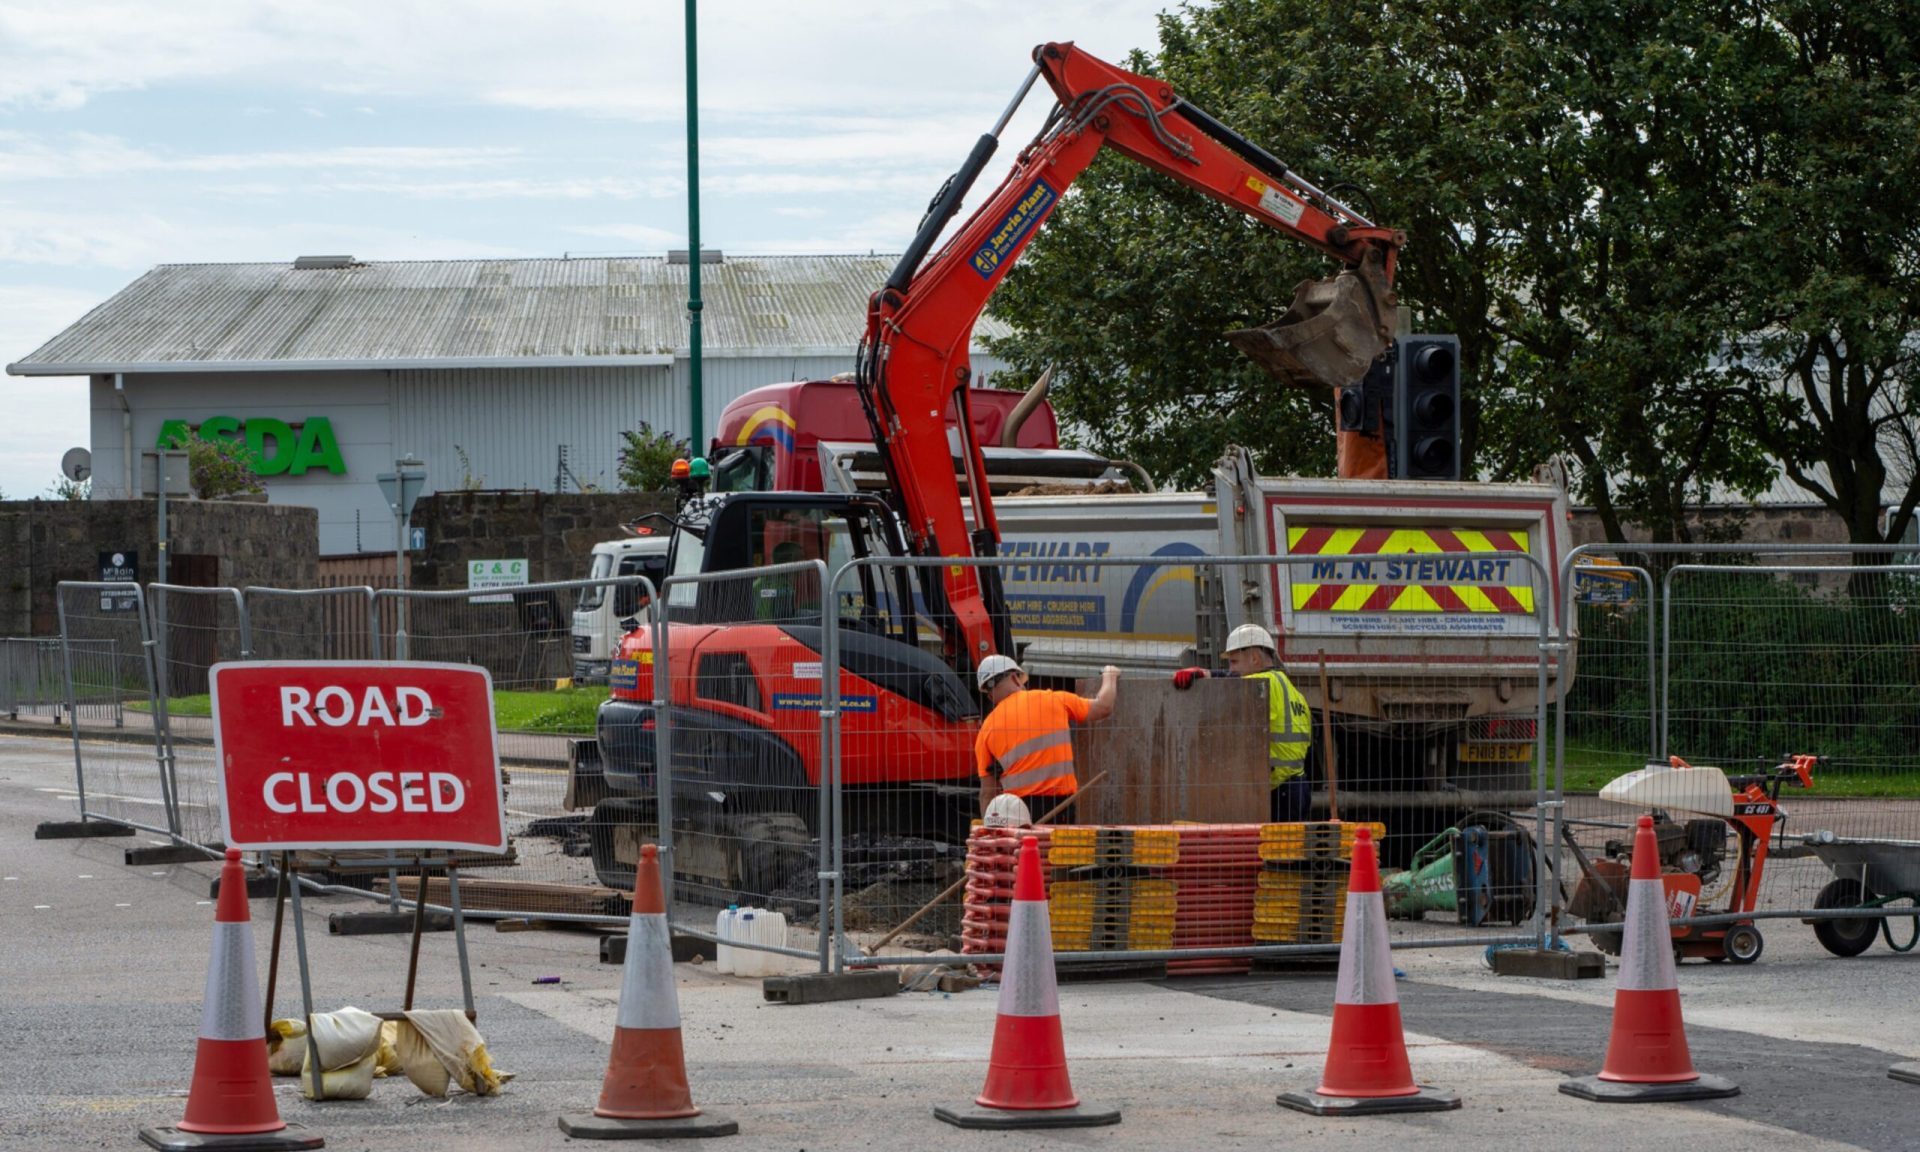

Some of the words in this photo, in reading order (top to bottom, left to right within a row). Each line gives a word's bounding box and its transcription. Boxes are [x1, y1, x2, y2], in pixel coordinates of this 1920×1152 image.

[990, 213, 1023, 249] Jarvie
[1017, 184, 1046, 216] Plant
[473, 562, 484, 575] C
[491, 562, 502, 574] &
[510, 561, 522, 574] C
[996, 542, 1110, 582] TEWART
[1311, 560, 1343, 580] M.
[1351, 560, 1377, 580] N.
[1386, 559, 1511, 582] STEWART
[1047, 601, 1078, 612] CRUSHER
[1079, 602, 1096, 613] HIRE
[1010, 614, 1041, 625] ECYCLED
[1041, 615, 1085, 626] AGGREGATES
[280, 685, 434, 727] ROAD
[779, 699, 871, 708] www.jarvint.co.uk
[262, 771, 466, 813] CLOSED
